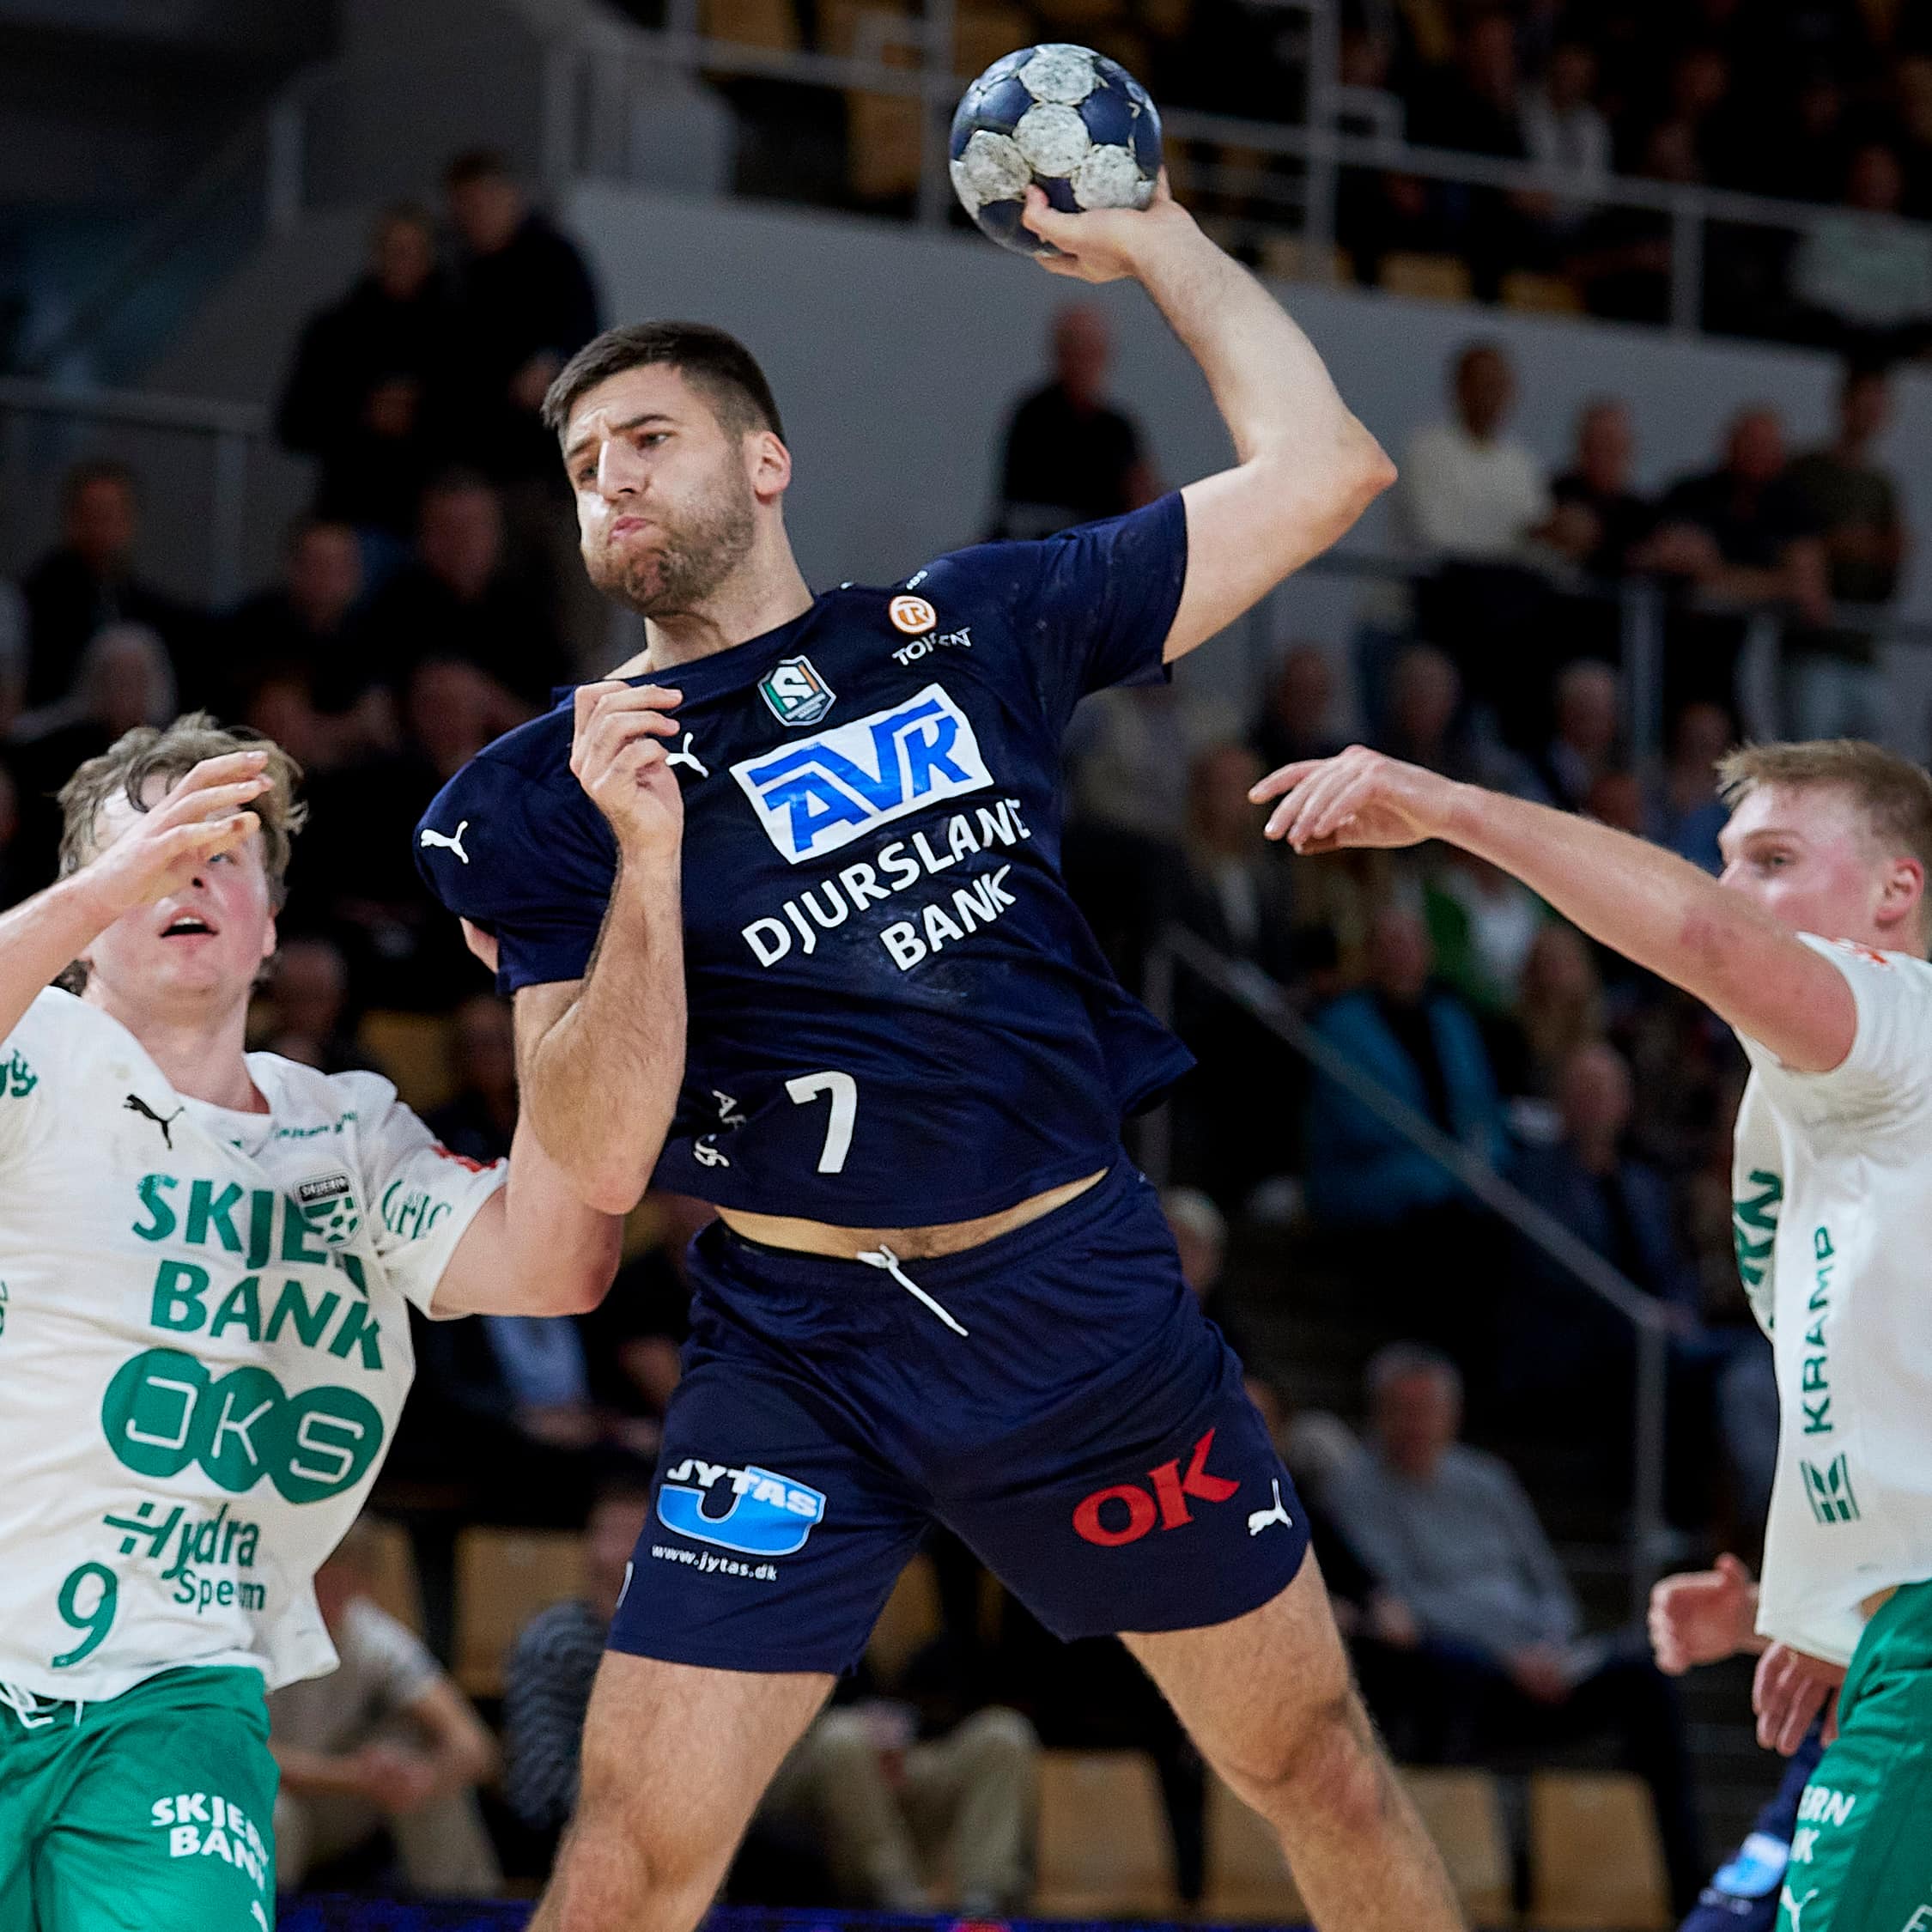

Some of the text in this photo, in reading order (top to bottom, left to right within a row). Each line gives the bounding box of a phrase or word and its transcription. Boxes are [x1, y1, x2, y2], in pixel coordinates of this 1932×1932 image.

[747, 699, 971, 853] AVK
[879, 864, 1016, 971] BANK
[785, 1071, 857, 1173] 7
[150, 1260, 383, 1370] BANK
[1802, 1226, 1834, 1434] KRAMP
[666, 1459, 817, 1517] JYTAS
[1072, 1427, 1240, 1546] OK
[102, 1503, 260, 1580] Hydra
[652, 1546, 778, 1582] www.jytas.dk
[57, 1562, 118, 1668] 9
